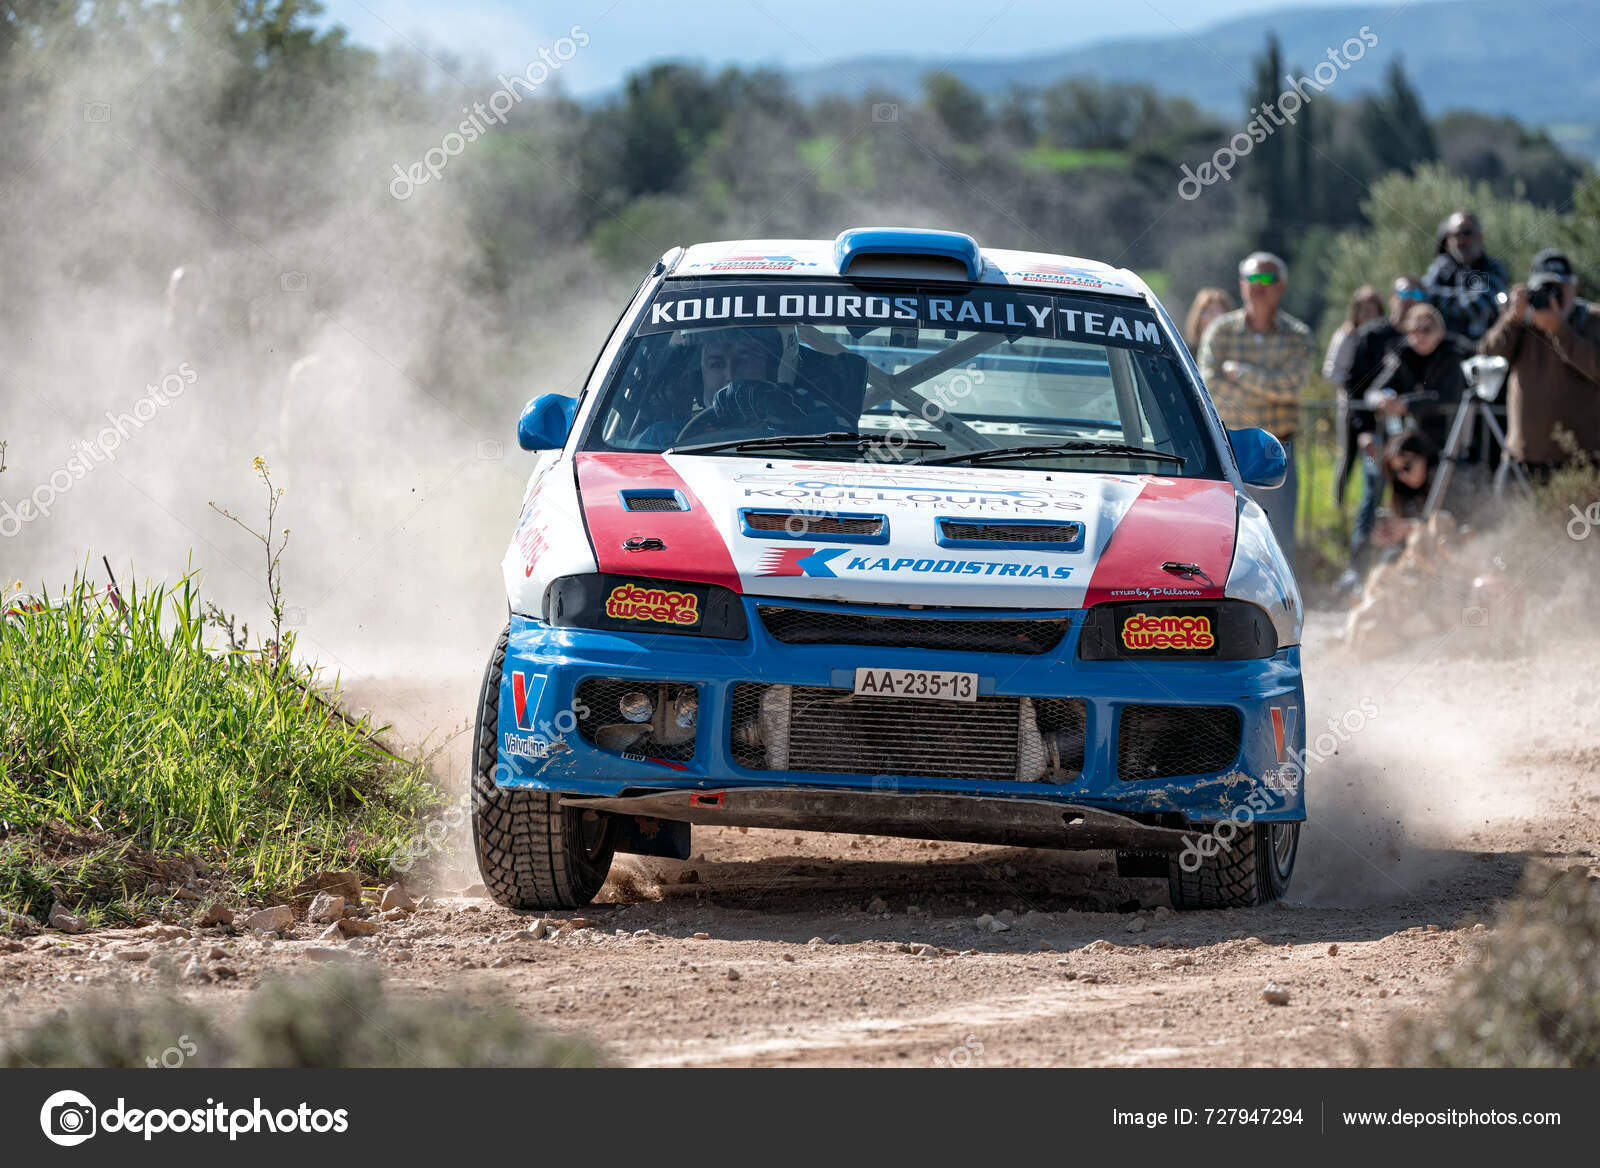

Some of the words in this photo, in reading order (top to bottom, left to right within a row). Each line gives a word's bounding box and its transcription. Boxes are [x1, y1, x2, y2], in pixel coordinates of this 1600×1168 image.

[651, 295, 918, 324] KOULLOUROS
[929, 299, 1052, 328] RALLY
[1059, 308, 1161, 345] TEAM
[744, 488, 1083, 511] KOULLOUROS
[846, 557, 1075, 579] KAPODISTRIAS
[611, 584, 698, 609] demon
[1136, 588, 1151, 599] by
[606, 598, 698, 624] tweeks
[1124, 613, 1211, 634] demon
[1122, 628, 1214, 650] tweeks
[861, 671, 972, 697] AA-235-13
